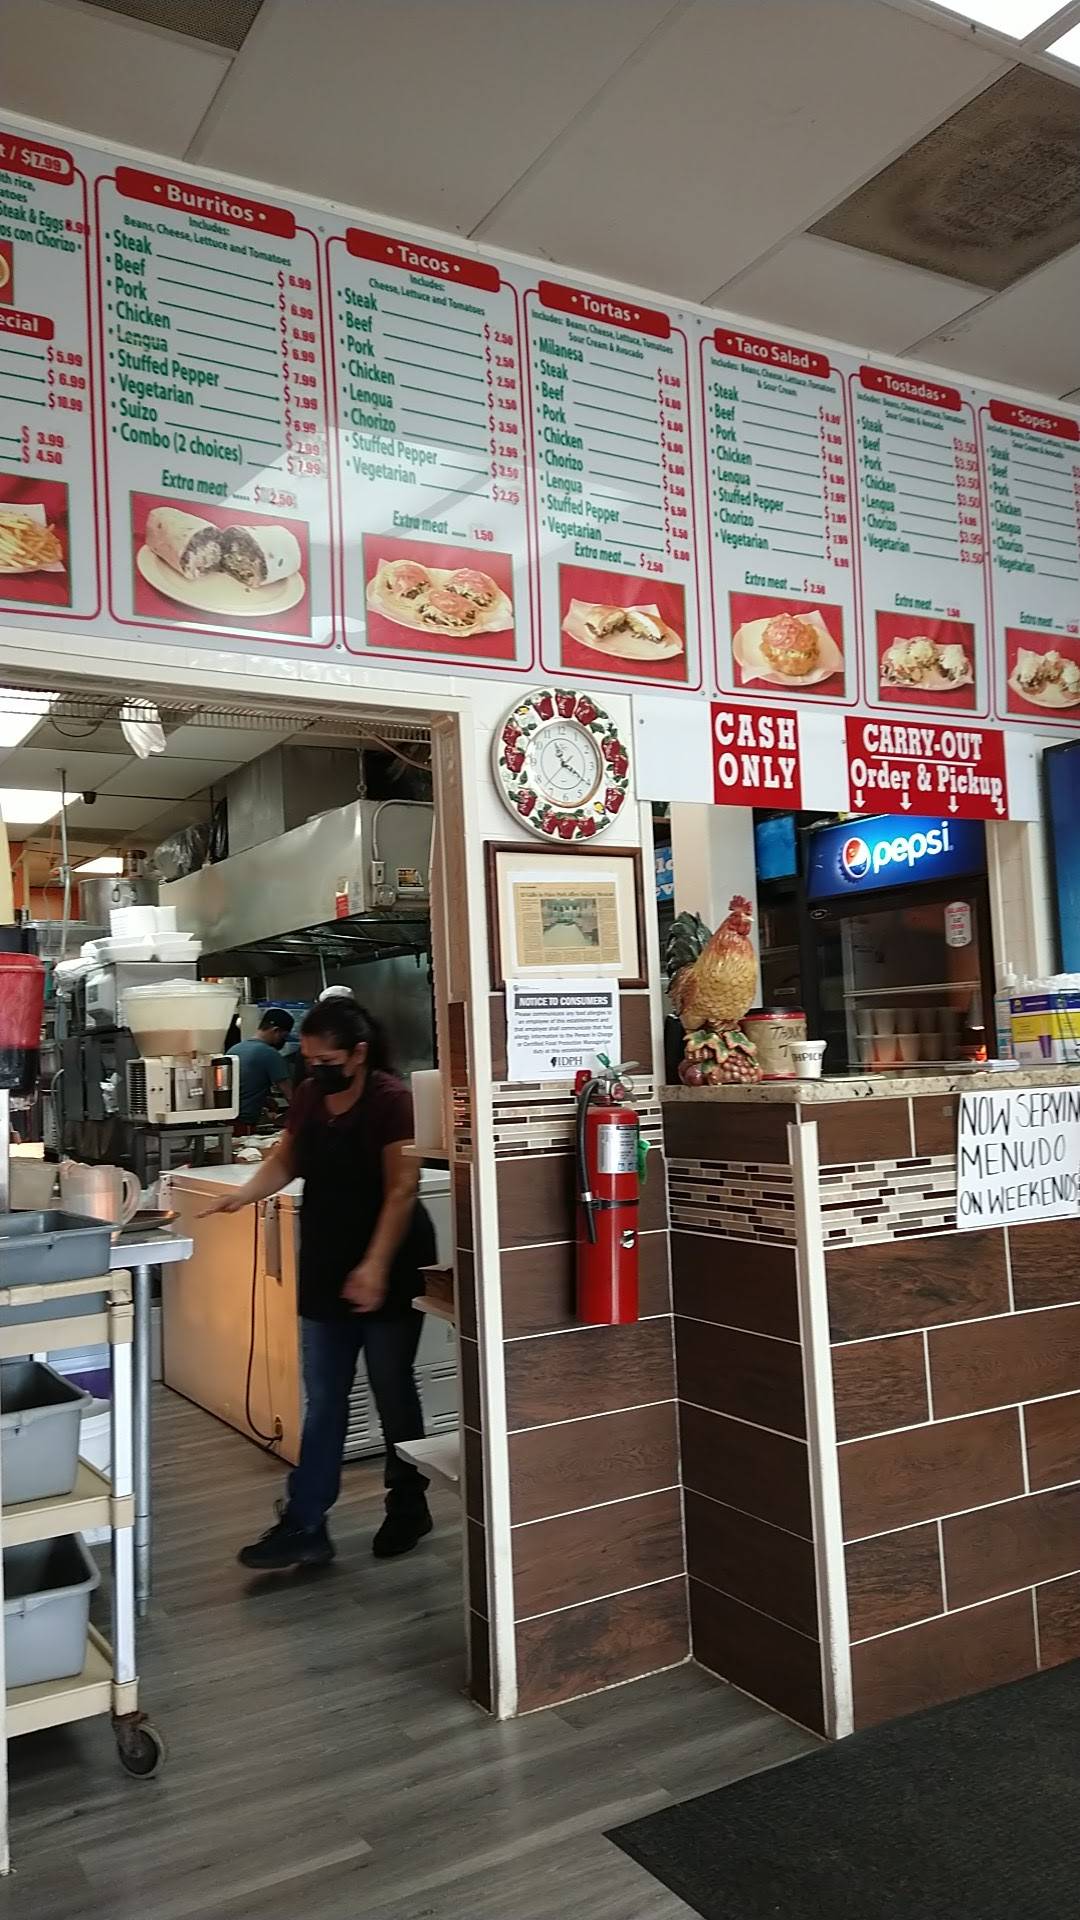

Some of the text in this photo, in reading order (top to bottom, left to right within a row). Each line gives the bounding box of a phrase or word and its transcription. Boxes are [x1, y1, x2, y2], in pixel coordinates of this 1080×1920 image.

[166, 184, 254, 222] Burritos
[29, 208, 37, 224] &
[39, 210, 65, 233] Eggs
[14, 227, 34, 243] con
[35, 229, 76, 253] Chorizo
[114, 229, 152, 255] Steak
[123, 214, 292, 267] Beans, Cheese, Lettuce and Tomatoes
[114, 253, 146, 276] Beef
[397, 245, 450, 274] Tacos
[115, 276, 148, 301] Pork
[344, 287, 378, 311] Steak
[368, 277, 485, 316] Cheese, Lettuce and Tomatoes
[116, 301, 171, 329] Chicken
[346, 310, 373, 332] Beef
[580, 294, 632, 322] Tortas
[117, 324, 168, 352] Lengua
[347, 335, 375, 357] Pork
[539, 337, 584, 362] Milanesa
[568, 332, 585, 345] Sour
[586, 336, 609, 351] Cream
[735, 337, 809, 368] Taco Salad
[118, 349, 169, 377] Stuffed
[172, 359, 219, 388] Pepper
[349, 359, 396, 385] Chicken
[540, 359, 569, 380] Steak
[118, 372, 194, 405] Vegetarian
[350, 383, 393, 410] Lengua
[541, 382, 565, 401] Beef
[713, 382, 739, 402] Steak
[883, 375, 940, 401] Tostadas
[120, 398, 158, 422] Suizo
[351, 408, 396, 432] Chorizo
[543, 404, 566, 424] Pork
[714, 403, 735, 421] Beef
[1017, 409, 1052, 429] Sopes
[120, 423, 170, 449] Combo
[173, 431, 187, 453] (2
[190, 438, 243, 465] choices)
[544, 427, 584, 449] Chicken
[716, 424, 737, 442] Pork
[352, 432, 438, 466] Stuffed Pepper
[545, 449, 584, 471] Chorizo
[717, 445, 752, 466] Chicken
[162, 469, 194, 491] Extra
[197, 478, 228, 497] meat
[352, 455, 416, 485] Vegetarian
[718, 466, 751, 488] Lengua
[546, 471, 583, 496] Lengua
[547, 494, 620, 524] Stuffed Pepper
[719, 487, 784, 514] Stuffed Pepper
[393, 510, 494, 542] Extra meat 1.50
[547, 516, 602, 541] Vegetarian
[720, 508, 754, 527] Chorizo
[575, 542, 598, 559] Extra
[599, 548, 622, 562] meat
[720, 528, 769, 550] Vegetarian
[745, 571, 766, 587] Extra
[767, 578, 788, 590] meat
[714, 711, 797, 750] CASH
[862, 723, 982, 760] CARRY-OUT
[717, 752, 796, 789] ONLY
[850, 758, 1003, 802] Order & Pickup
[872, 820, 951, 874] pepsi
[519, 996, 609, 1006] NOTICE TO CONSUMERS
[557, 1056, 583, 1066] IDPH
[961, 1096, 1011, 1136] NOW
[961, 1134, 1067, 1179] MENUDO
[960, 1172, 1080, 1216] ON WEEKENDS
